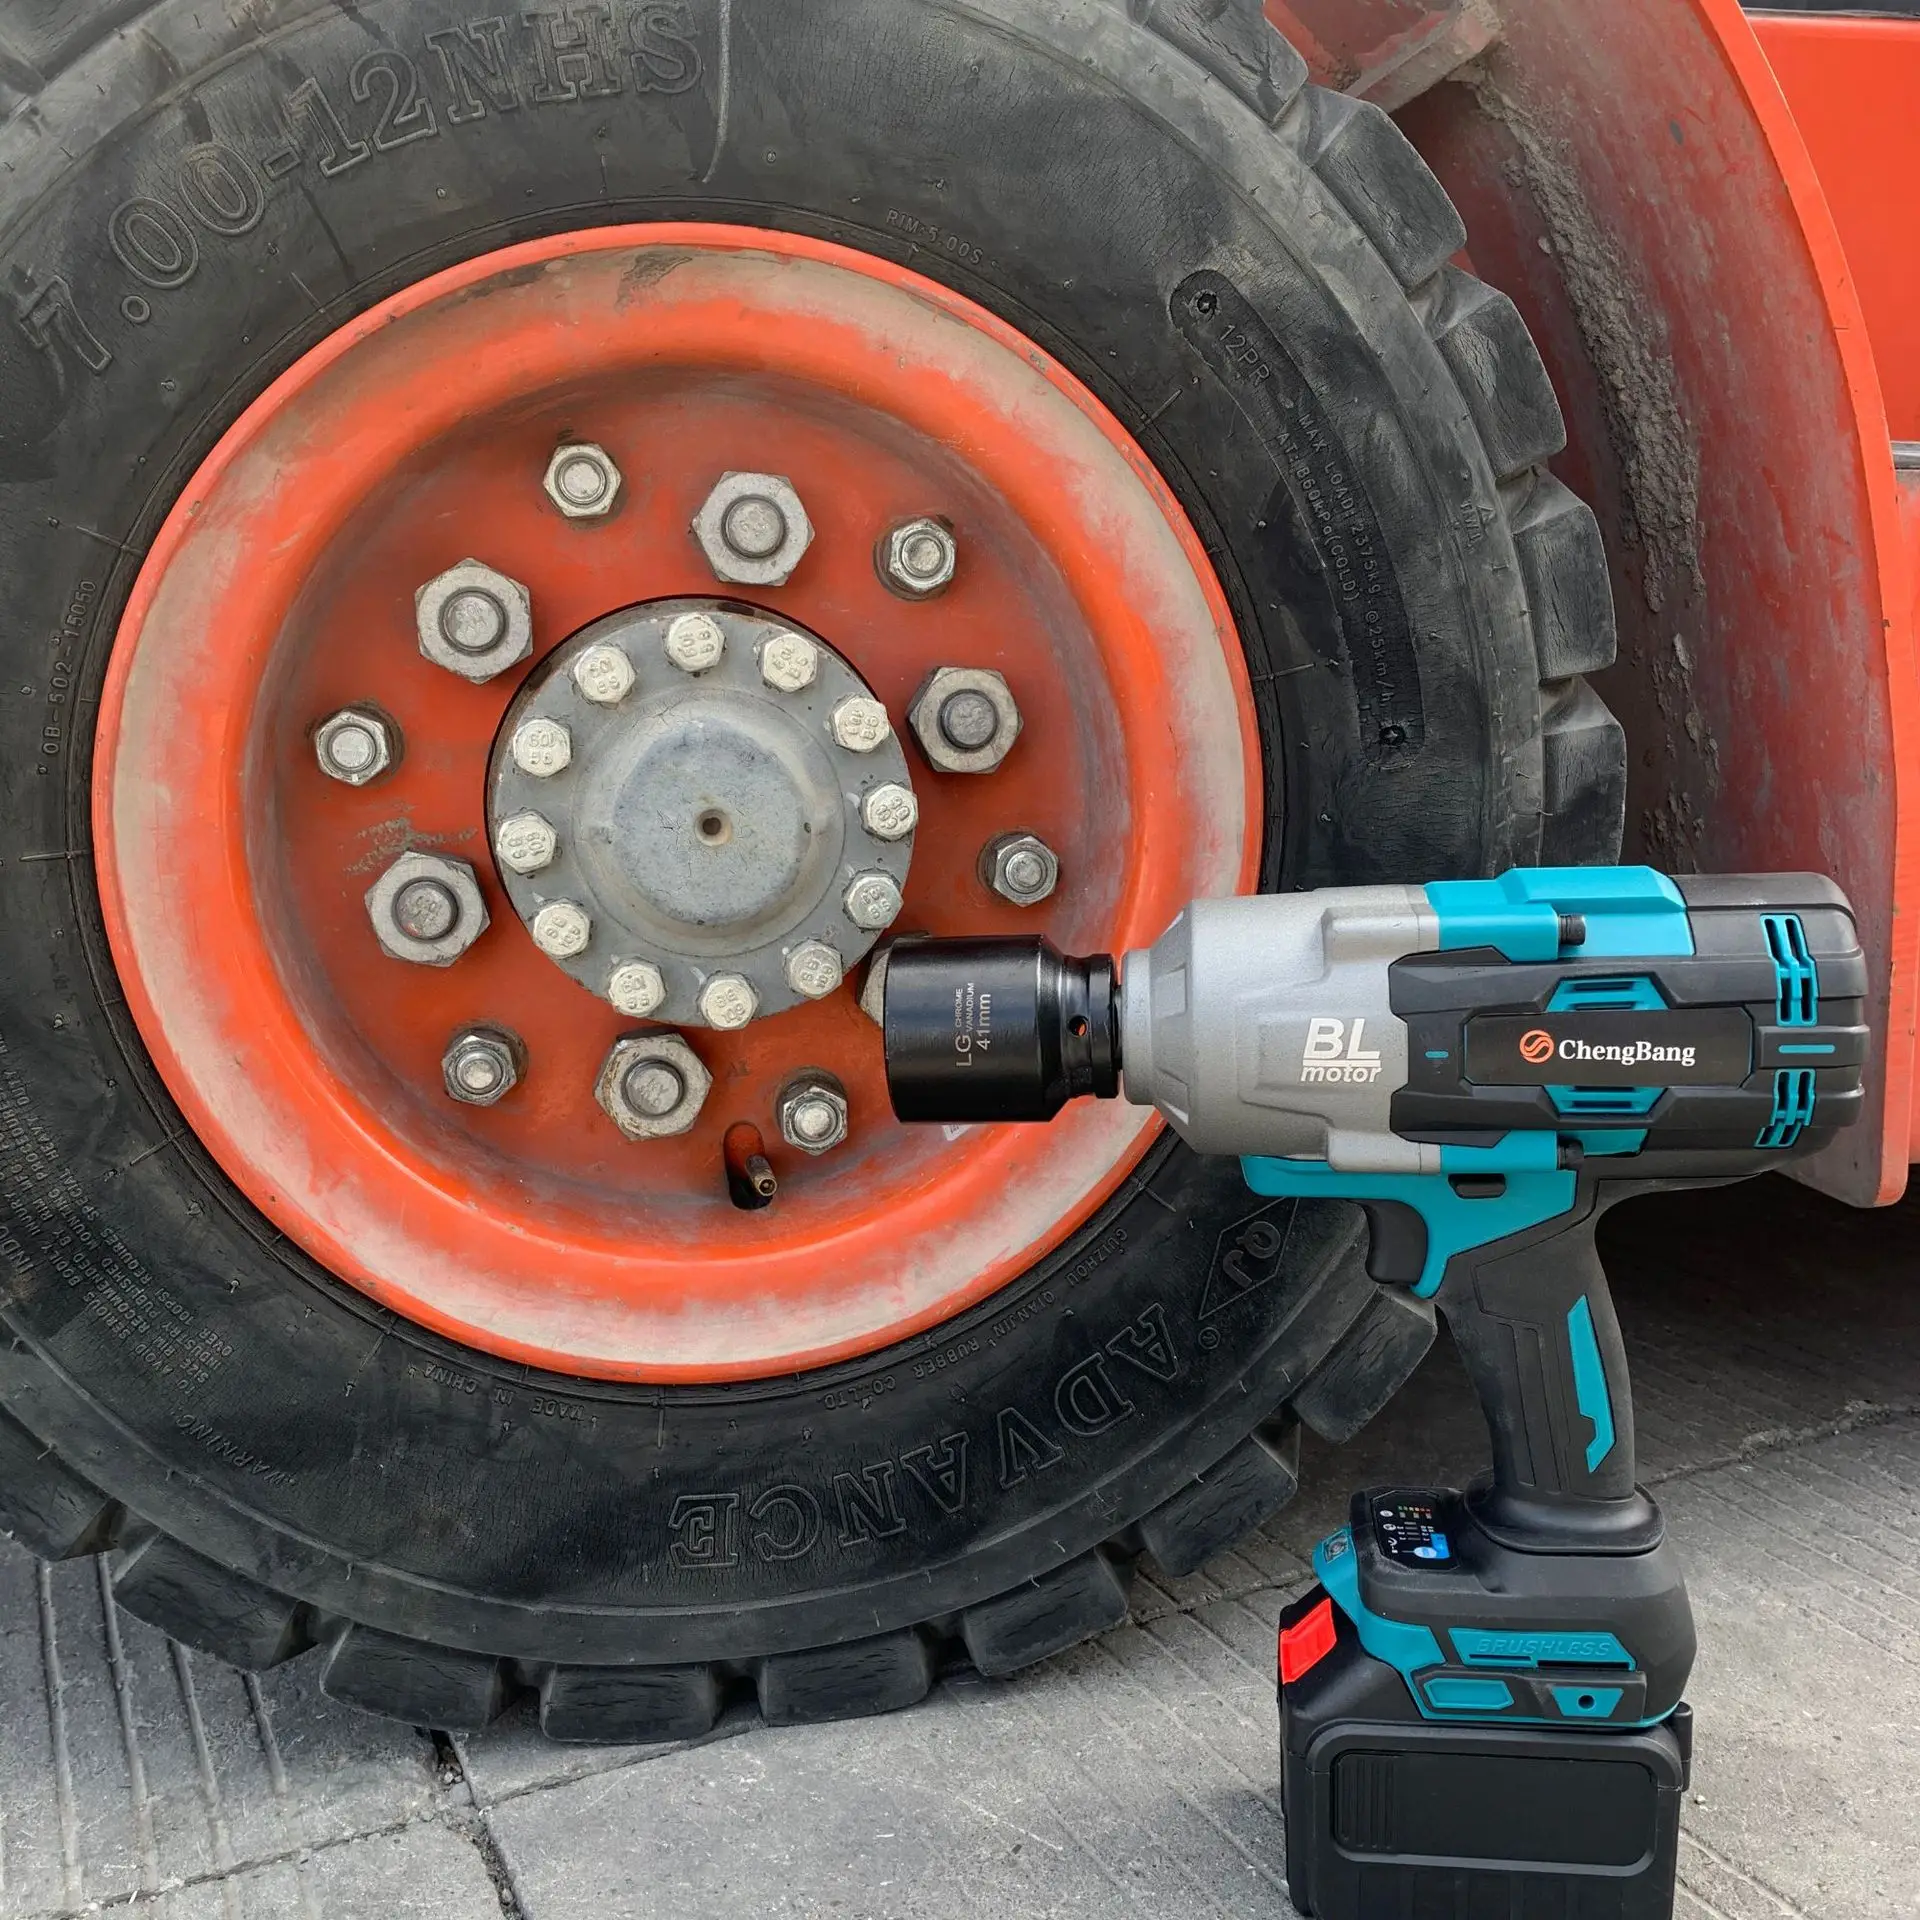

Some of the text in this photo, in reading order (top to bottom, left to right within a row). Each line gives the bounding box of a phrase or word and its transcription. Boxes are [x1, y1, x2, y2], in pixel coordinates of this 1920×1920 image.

[1217, 324, 1271, 386] 12PR
[1297, 415, 1325, 453] MAX
[955, 988, 972, 1067] LG CHROME
[966, 983, 975, 1032] VANADIUM
[976, 993, 991, 1050] 41mm
[1303, 1017, 1382, 1060] BL
[1558, 1039, 1695, 1067] ChengBang
[1300, 1064, 1382, 1083] motor
[1221, 1220, 1282, 1288] QJ
[911, 1338, 981, 1379] RUBBER
[421, 1362, 583, 1420] MADE IN CHINA
[670, 1302, 1186, 1568] ADVANCE
[1475, 1638, 1612, 1656] BRUSHLESS
